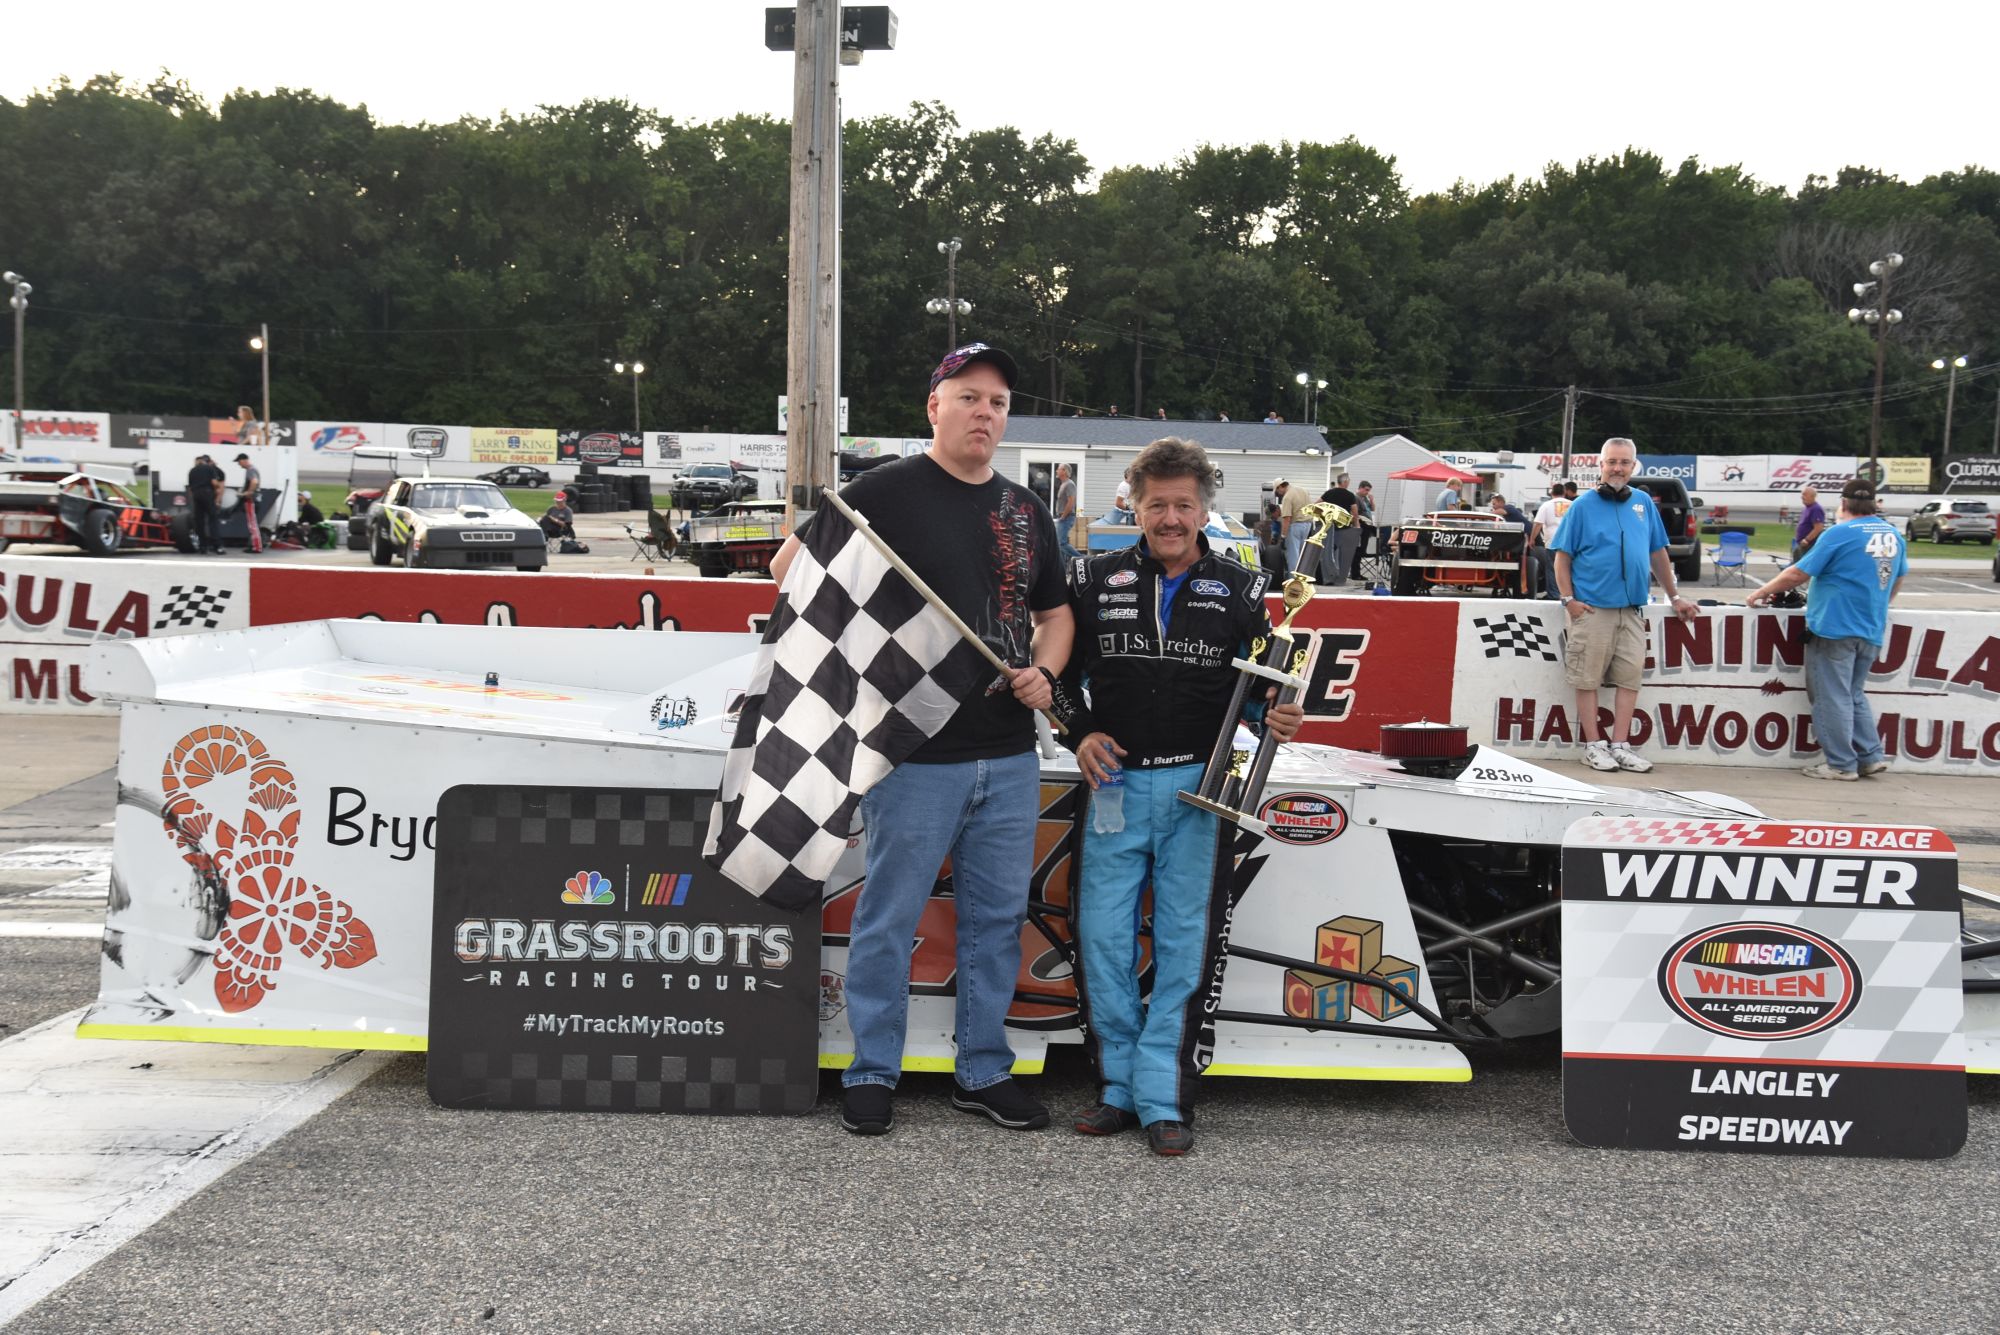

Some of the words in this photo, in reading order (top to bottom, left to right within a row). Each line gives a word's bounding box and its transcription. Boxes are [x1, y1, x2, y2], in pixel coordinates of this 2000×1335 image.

[472, 438, 506, 449] LARRY
[522, 440, 551, 449] KING
[740, 444, 772, 452] HARRIS
[1567, 454, 1600, 467] KOOL
[1646, 464, 1695, 477] pepsi
[1769, 481, 1806, 489] CITY
[1431, 531, 1458, 544] Play
[1460, 533, 1492, 546] Time
[1196, 580, 1223, 594] Ford
[0, 573, 149, 638] ULA
[1109, 607, 1139, 616] state
[1187, 601, 1226, 612] GOODYEAR
[659, 698, 689, 723] 89
[657, 717, 687, 731] Skip
[1153, 753, 1194, 765] Burton
[1291, 802, 1326, 812] NASCAR
[1273, 812, 1333, 827] WHELEN
[1275, 827, 1329, 835] ALL-AMERICAN
[1787, 827, 1853, 847] 2019
[1858, 829, 1933, 849] RACE
[1601, 852, 1919, 906] WINNER
[454, 917, 794, 970] GRASSROOTS
[1735, 943, 1809, 966] NASCAR
[489, 970, 635, 990] RACING
[661, 973, 758, 992] TOUR
[1693, 968, 1826, 998] WHELEN
[1701, 1002, 1819, 1015] ALL-AMERICAN
[523, 1013, 725, 1037] #MyTrackMyRoots
[1732, 1014, 1787, 1025] SERIES
[1690, 1068, 1840, 1098] LANGLEY
[1678, 1115, 1853, 1146] SPEEDWAY
